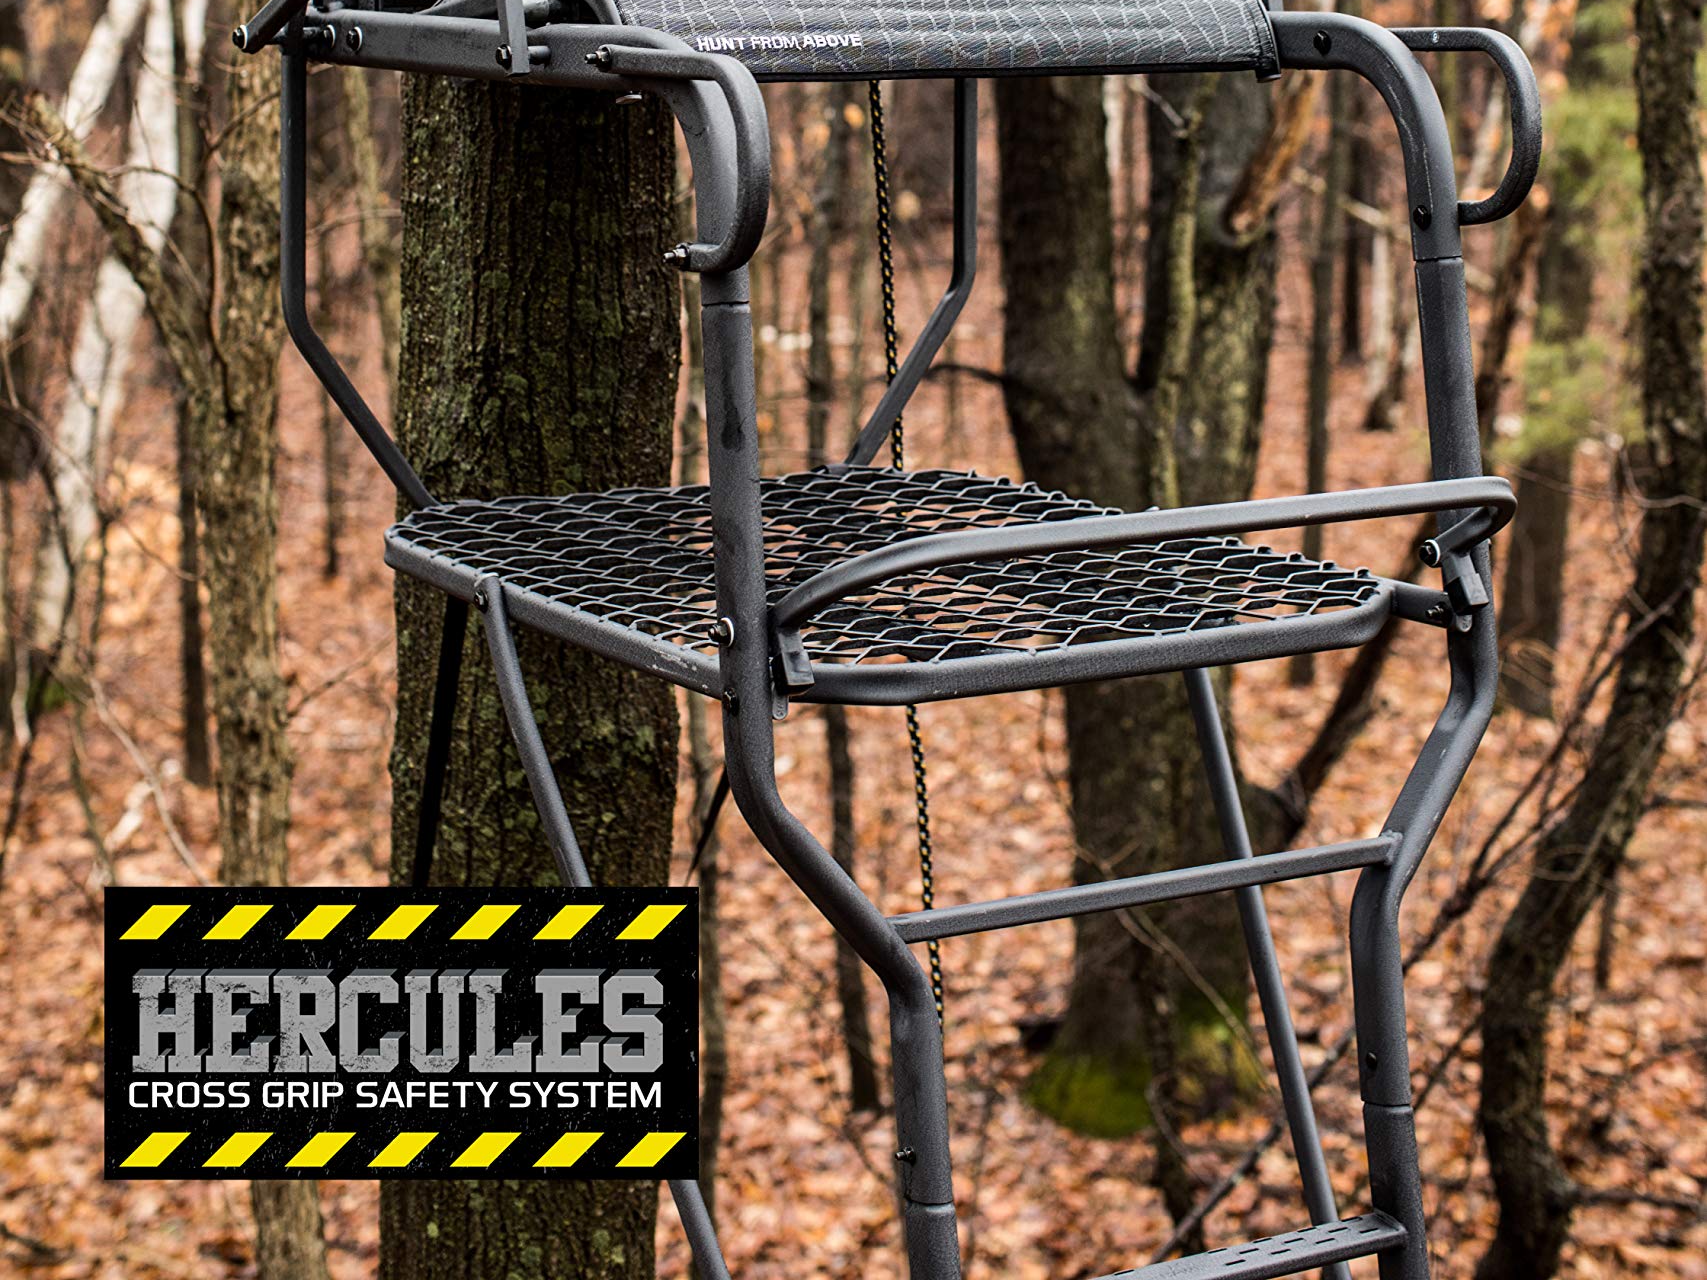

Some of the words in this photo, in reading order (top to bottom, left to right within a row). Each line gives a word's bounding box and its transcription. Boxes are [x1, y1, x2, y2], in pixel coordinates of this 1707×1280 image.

[697, 35, 745, 51] HUNT
[750, 35, 800, 50] FROM
[803, 33, 862, 47] ABOVE
